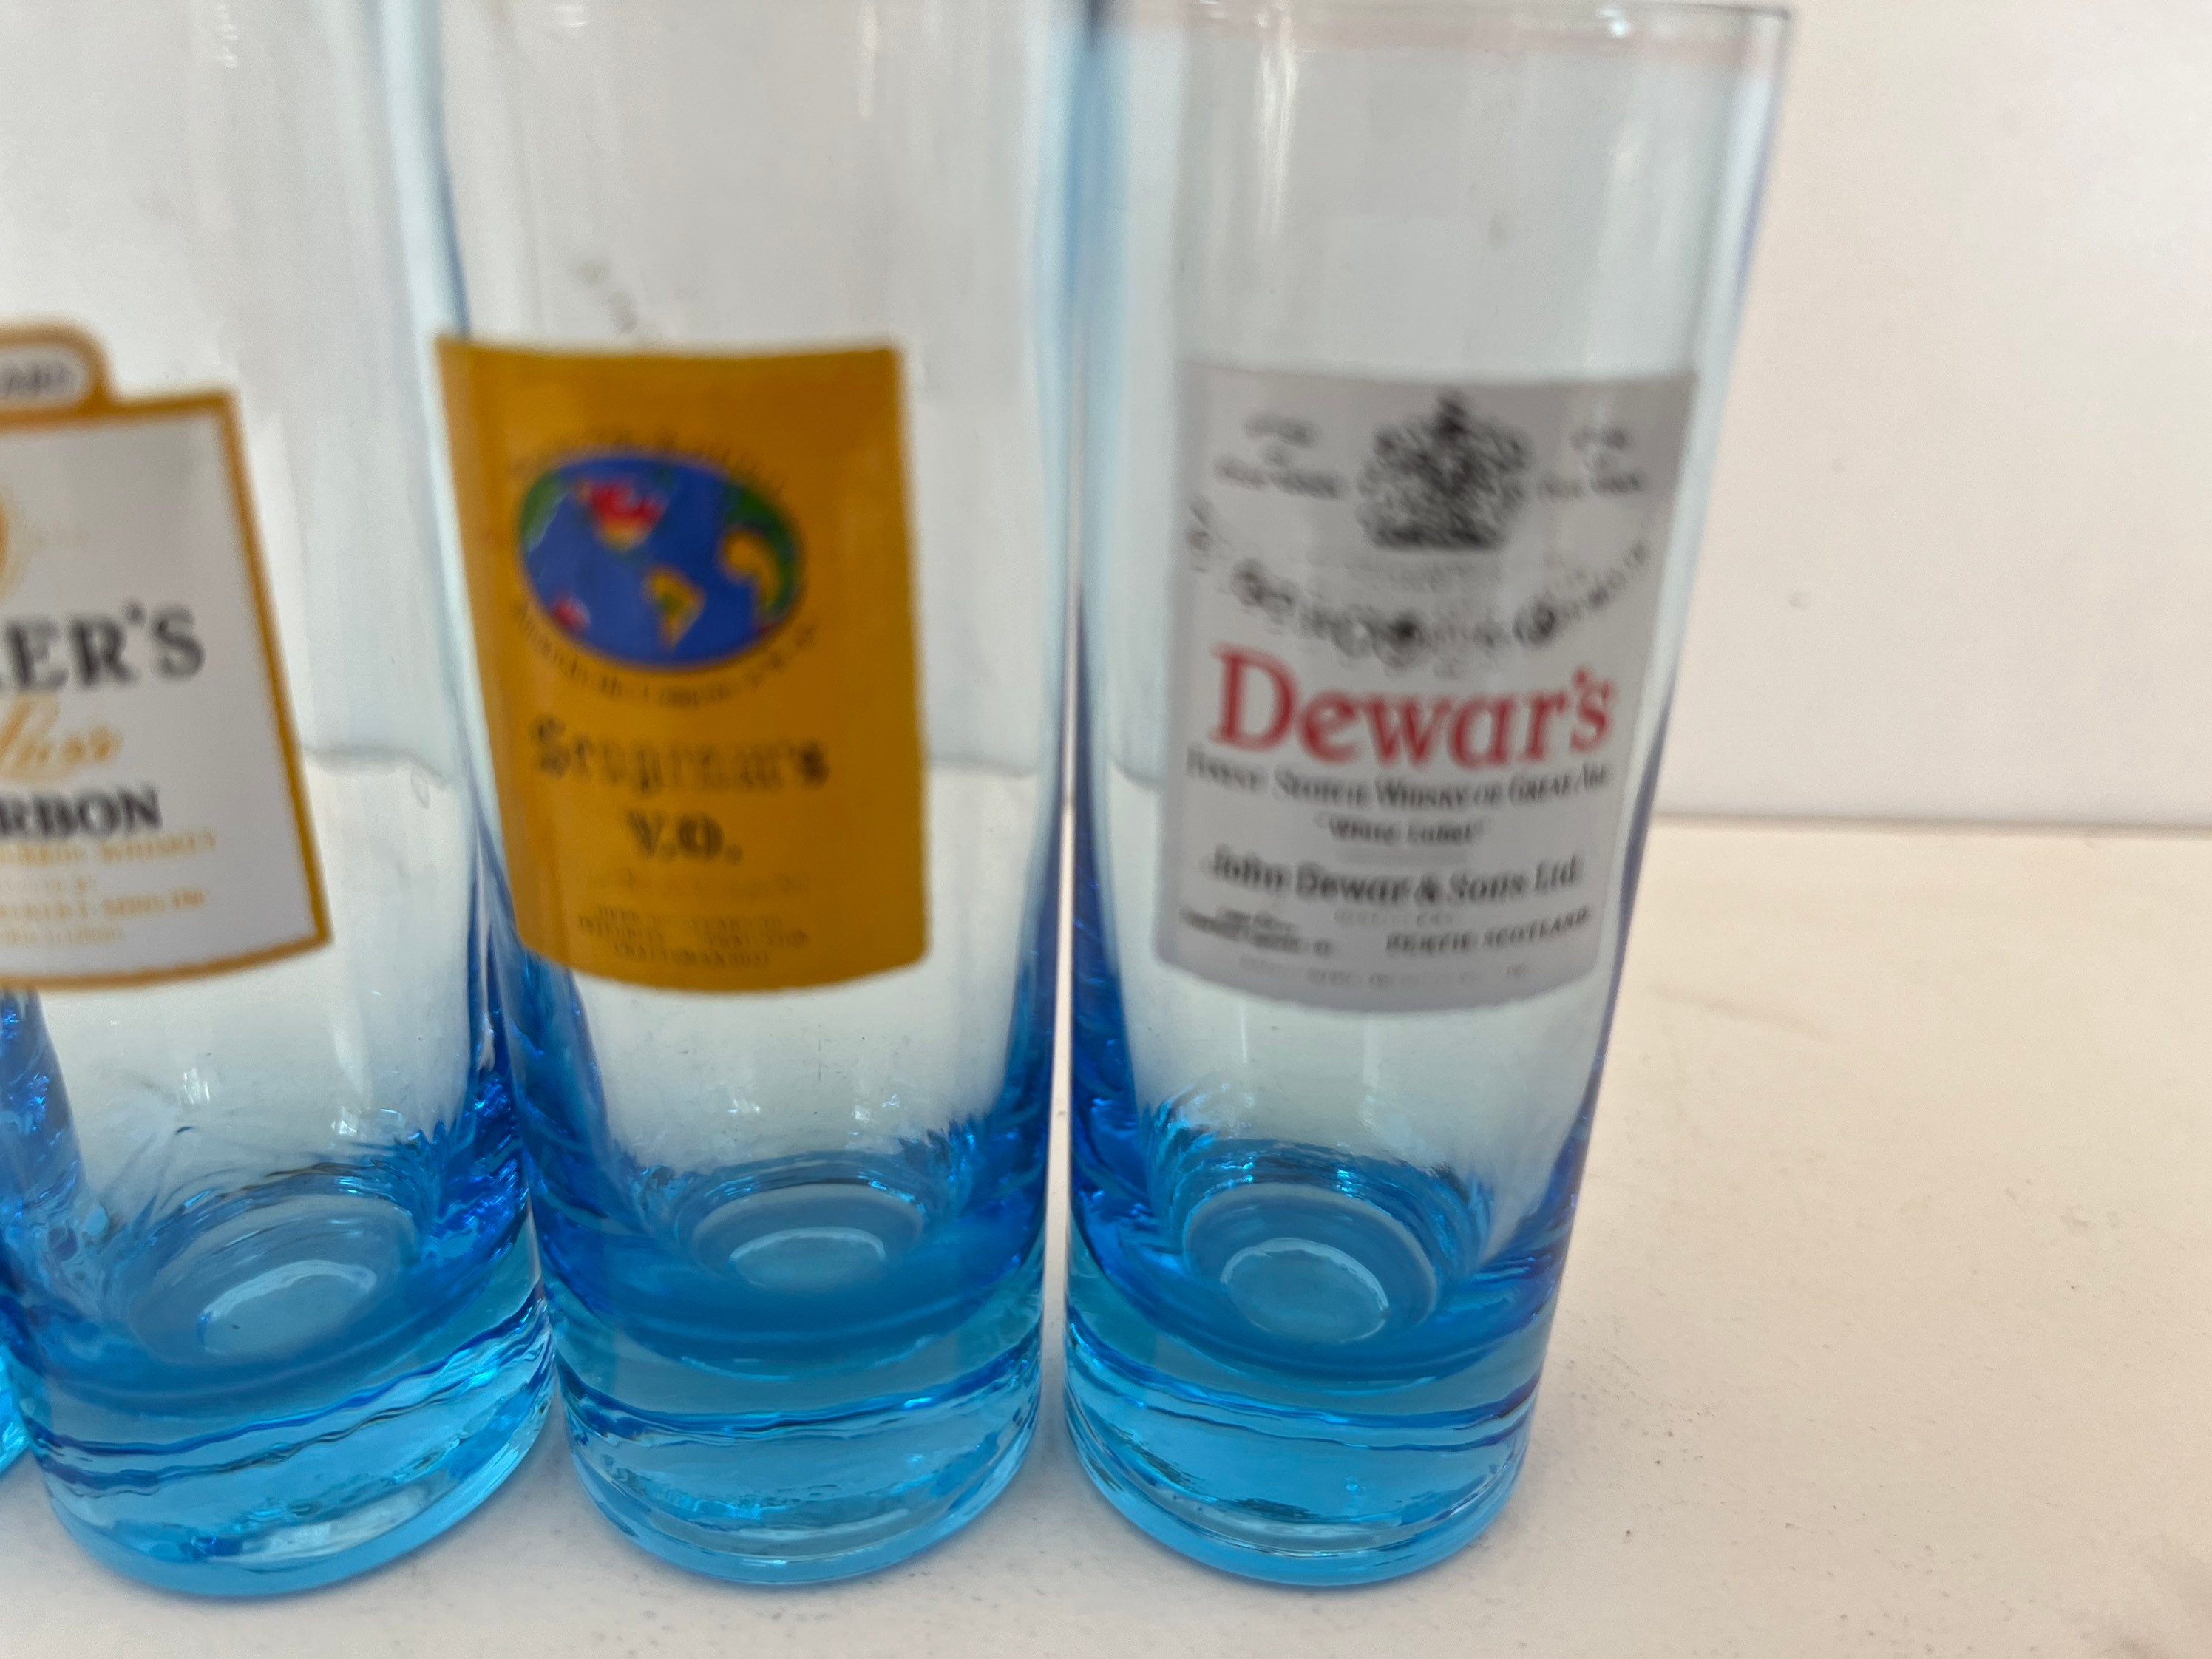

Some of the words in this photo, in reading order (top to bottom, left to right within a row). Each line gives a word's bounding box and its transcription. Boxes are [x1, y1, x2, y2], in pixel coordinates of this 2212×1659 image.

[0, 597, 205, 692] ER'S
[1210, 642, 1617, 772] Dewar's
[1200, 842, 1290, 894] John
[1295, 859, 1408, 904] Dewar
[1414, 870, 1444, 905] &
[1448, 866, 1530, 903] Sons
